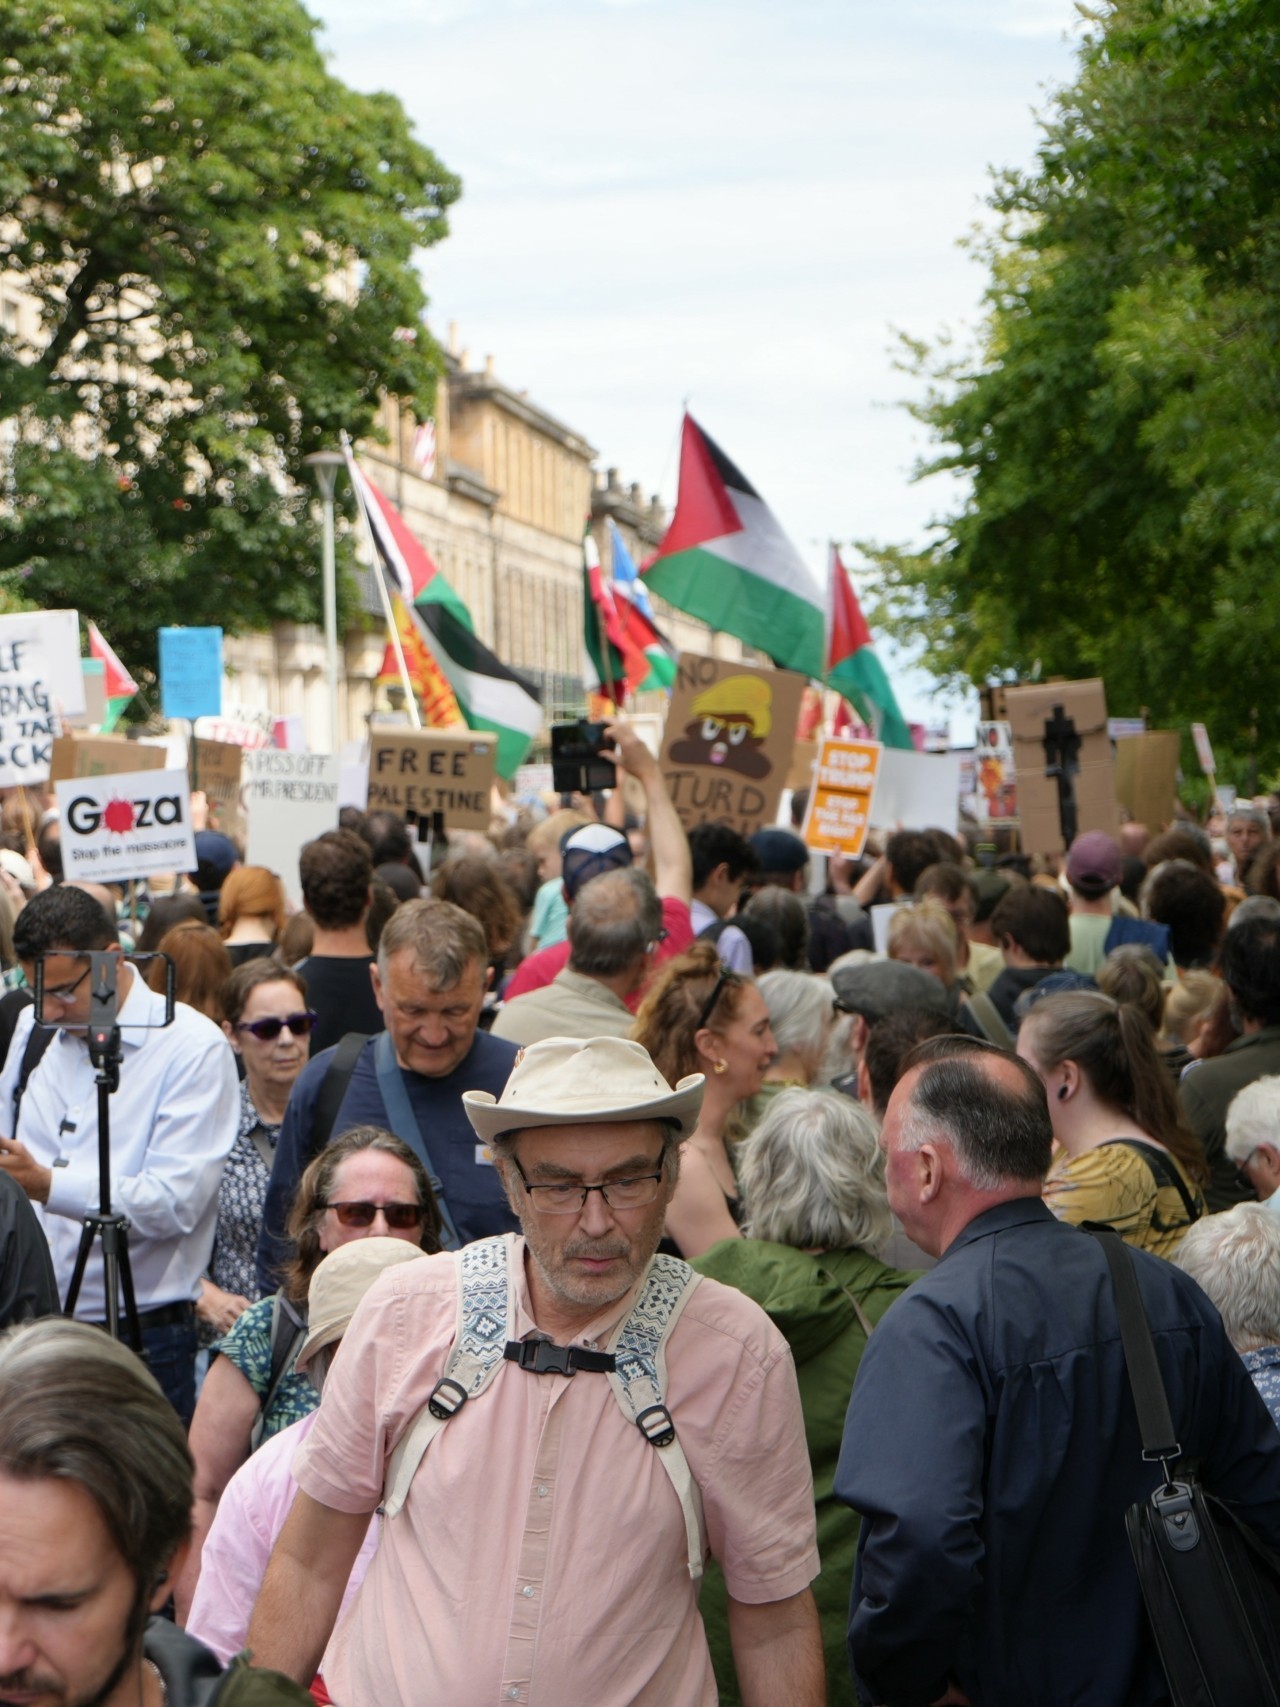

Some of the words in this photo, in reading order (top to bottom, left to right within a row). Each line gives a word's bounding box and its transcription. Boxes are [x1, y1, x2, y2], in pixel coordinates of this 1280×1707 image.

[677, 657, 718, 691] NO
[17, 716, 57, 738] TAE
[256, 752, 294, 775] PISS
[296, 753, 332, 776] OFF
[375, 746, 468, 777] FREE
[829, 749, 871, 768] STOP
[820, 766, 874, 790] TRUMP
[368, 781, 486, 813] PALESTINE
[664, 769, 766, 818] TURD
[71, 848, 100, 861] Stop
[102, 844, 122, 857] the
